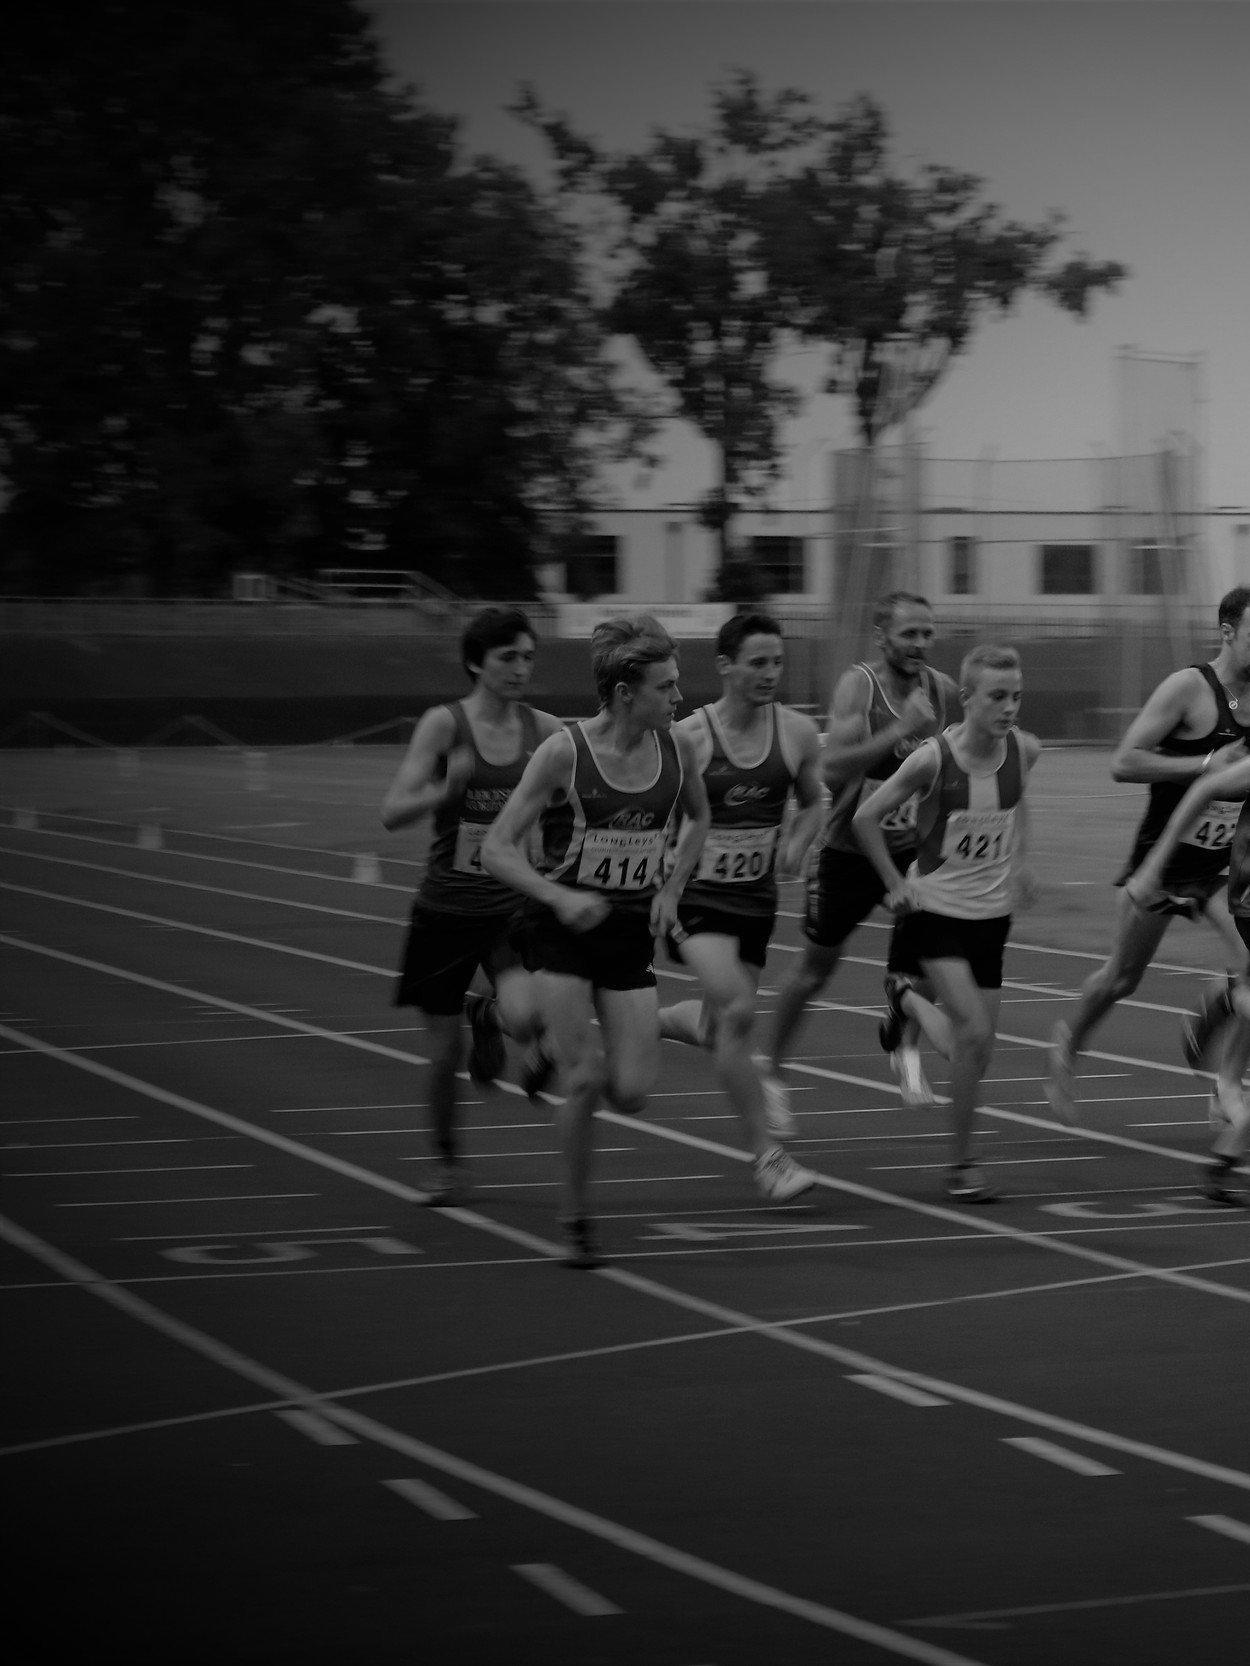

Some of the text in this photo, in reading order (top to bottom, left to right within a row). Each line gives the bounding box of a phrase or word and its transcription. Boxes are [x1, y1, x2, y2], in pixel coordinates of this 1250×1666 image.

[956, 833, 1004, 860] 421
[594, 857, 648, 885] 414
[714, 851, 764, 878] 420
